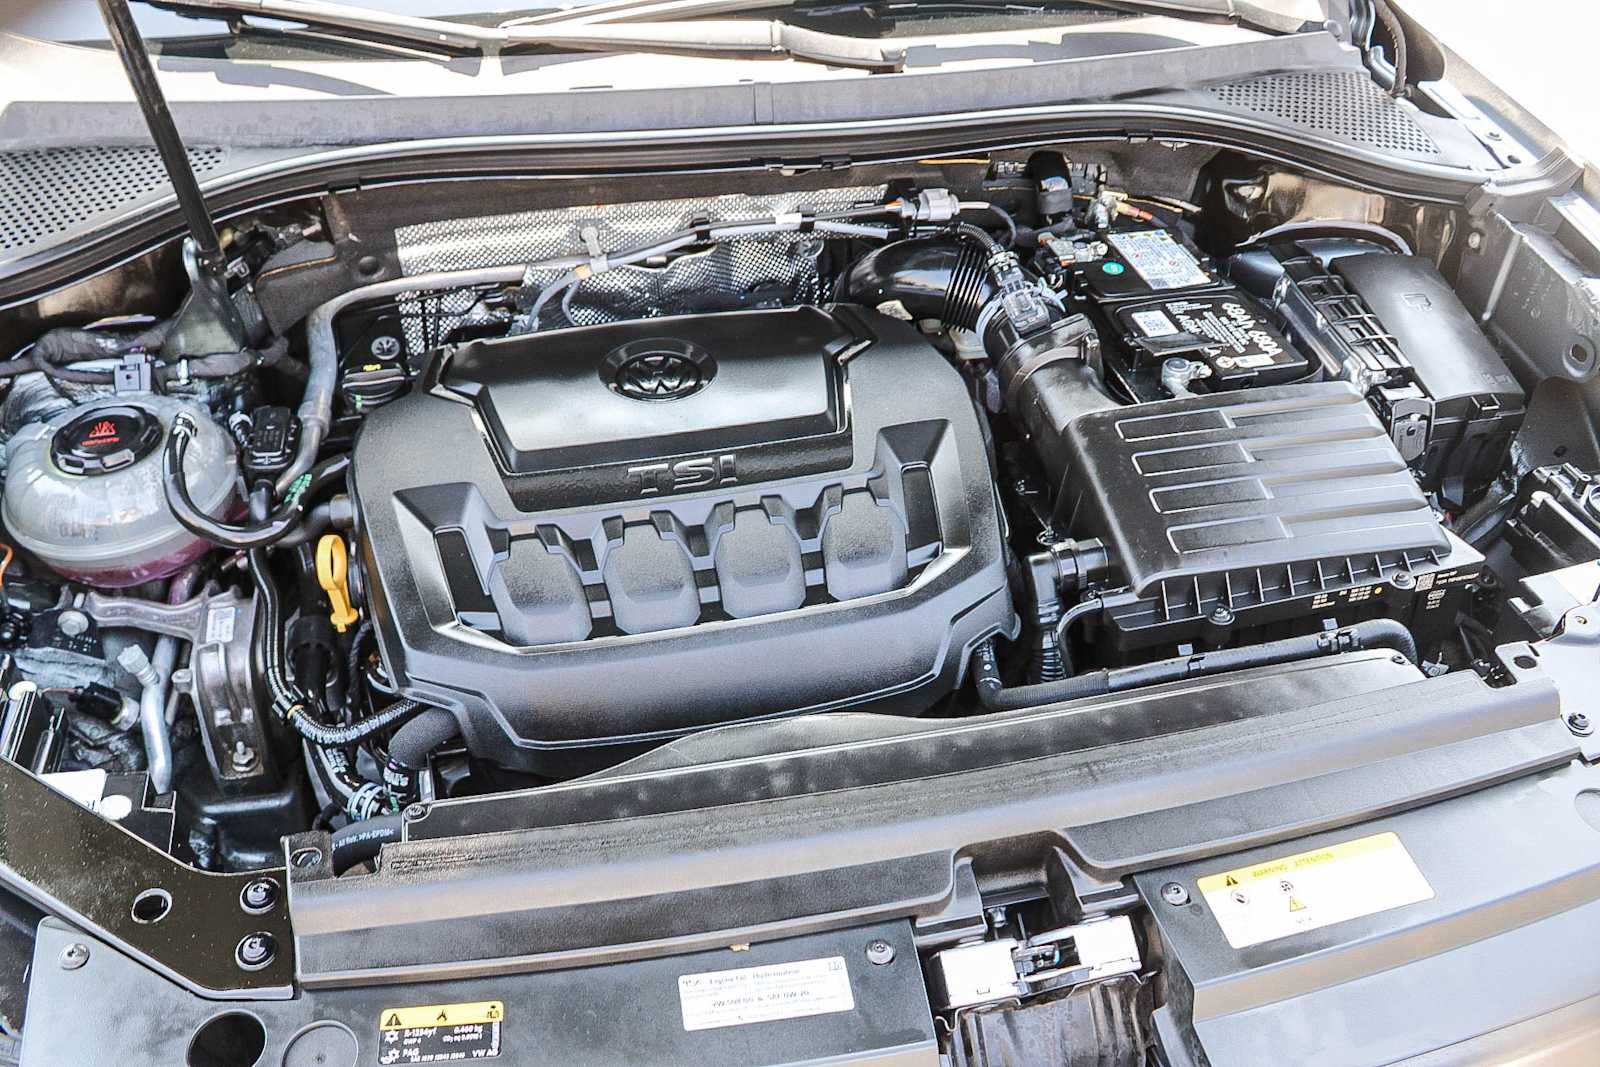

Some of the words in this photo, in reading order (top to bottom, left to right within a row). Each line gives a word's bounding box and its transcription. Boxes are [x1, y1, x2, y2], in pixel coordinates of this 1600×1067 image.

[626, 453, 738, 495] TSI
[402, 1047, 420, 1057] PAG
[472, 1049, 486, 1057] VW
